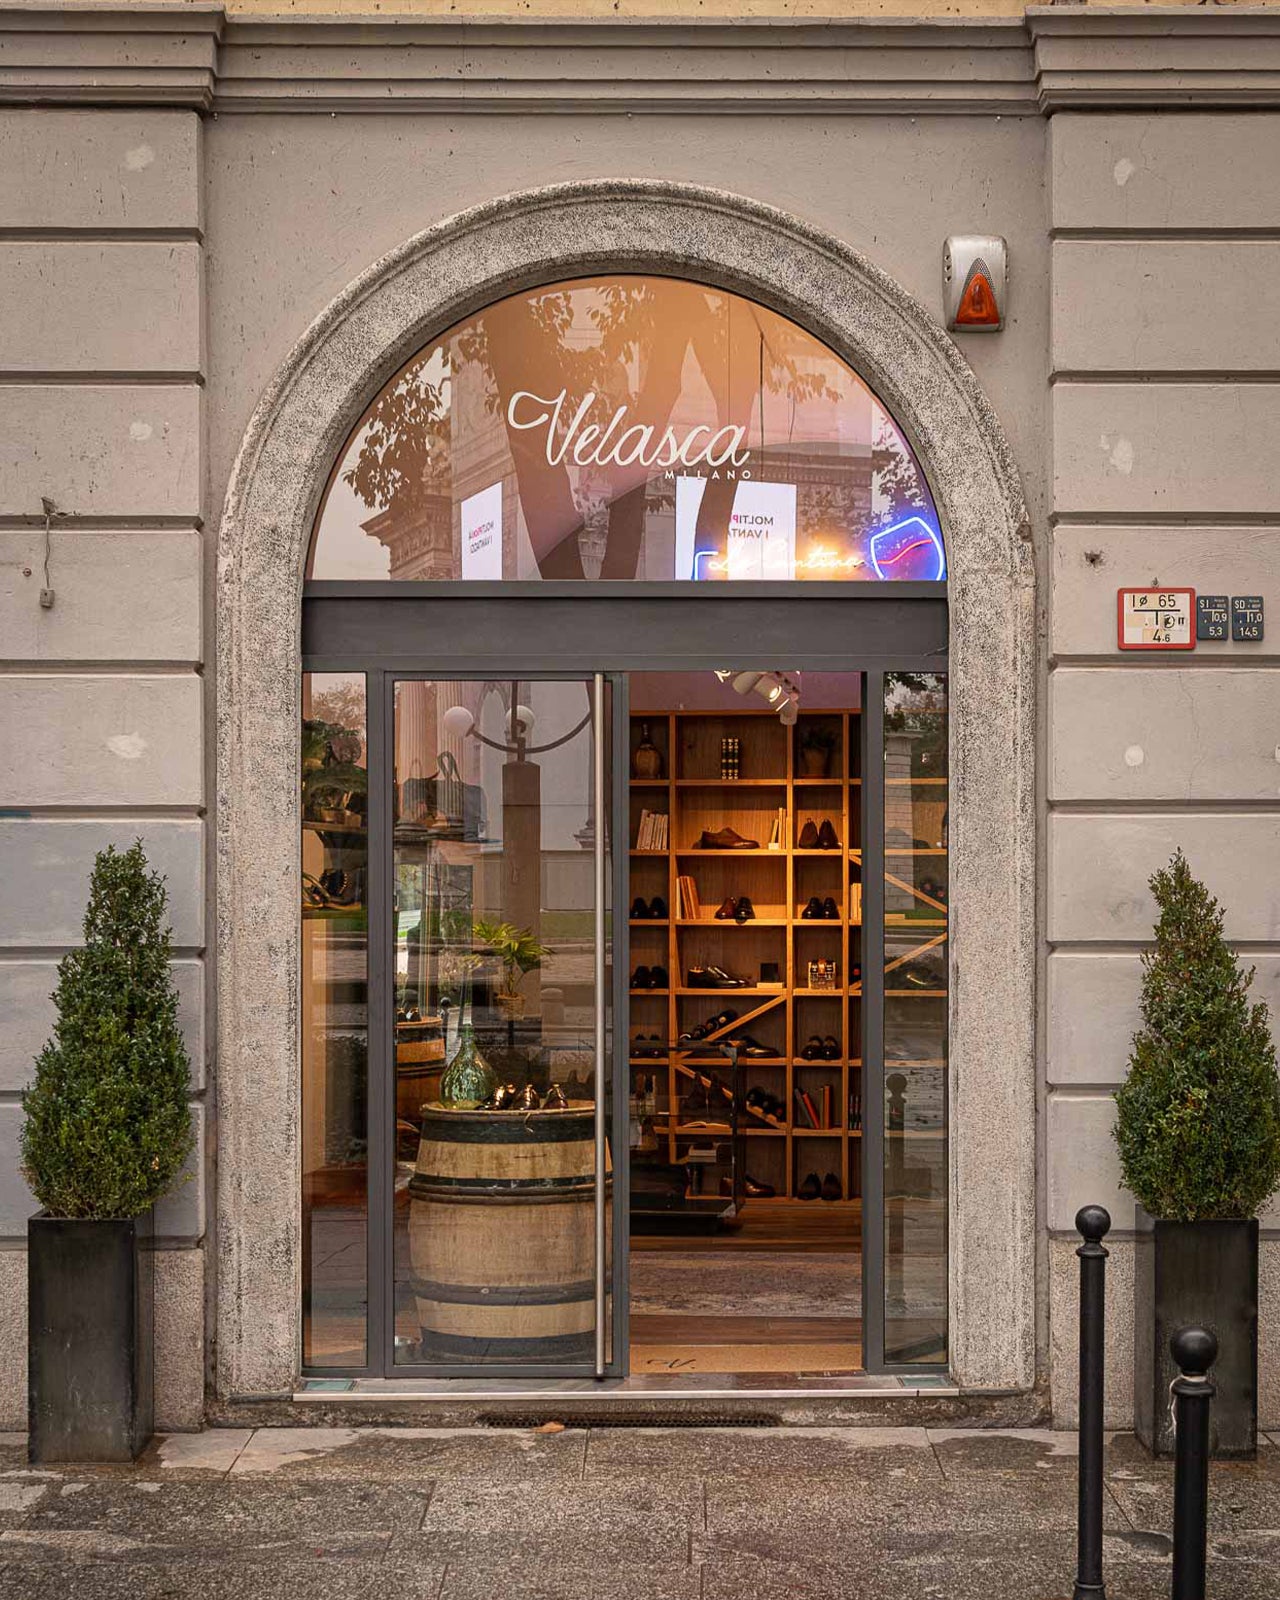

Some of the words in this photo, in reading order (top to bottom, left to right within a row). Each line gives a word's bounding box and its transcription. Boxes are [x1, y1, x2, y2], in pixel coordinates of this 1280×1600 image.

[507, 388, 750, 467] Velasca
[664, 470, 752, 480] MILANO
[1158, 594, 1176, 608] 65
